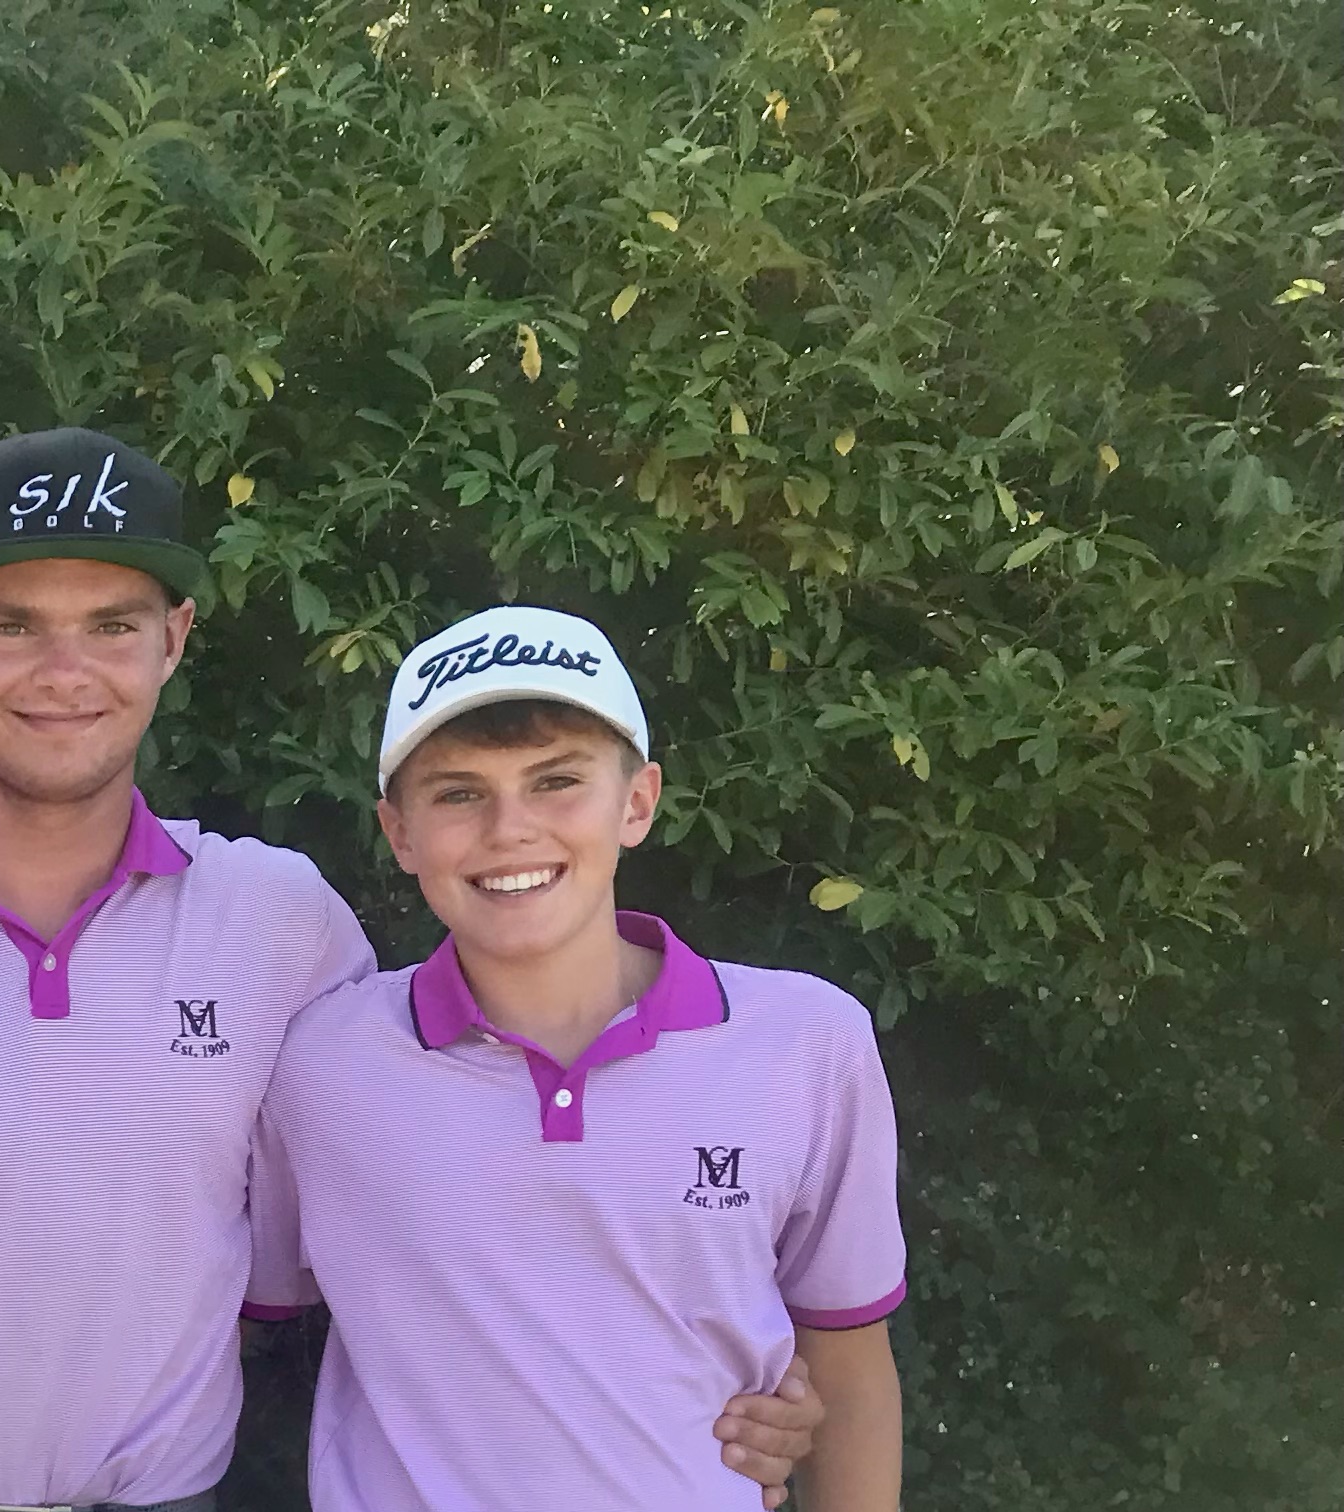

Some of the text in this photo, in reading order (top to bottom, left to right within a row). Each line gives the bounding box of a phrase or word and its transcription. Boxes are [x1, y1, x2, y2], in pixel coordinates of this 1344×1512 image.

[408, 632, 601, 710] Titleist
[170, 1039, 230, 1058] Est. 1909
[683, 1189, 750, 1210] Est. 1909
